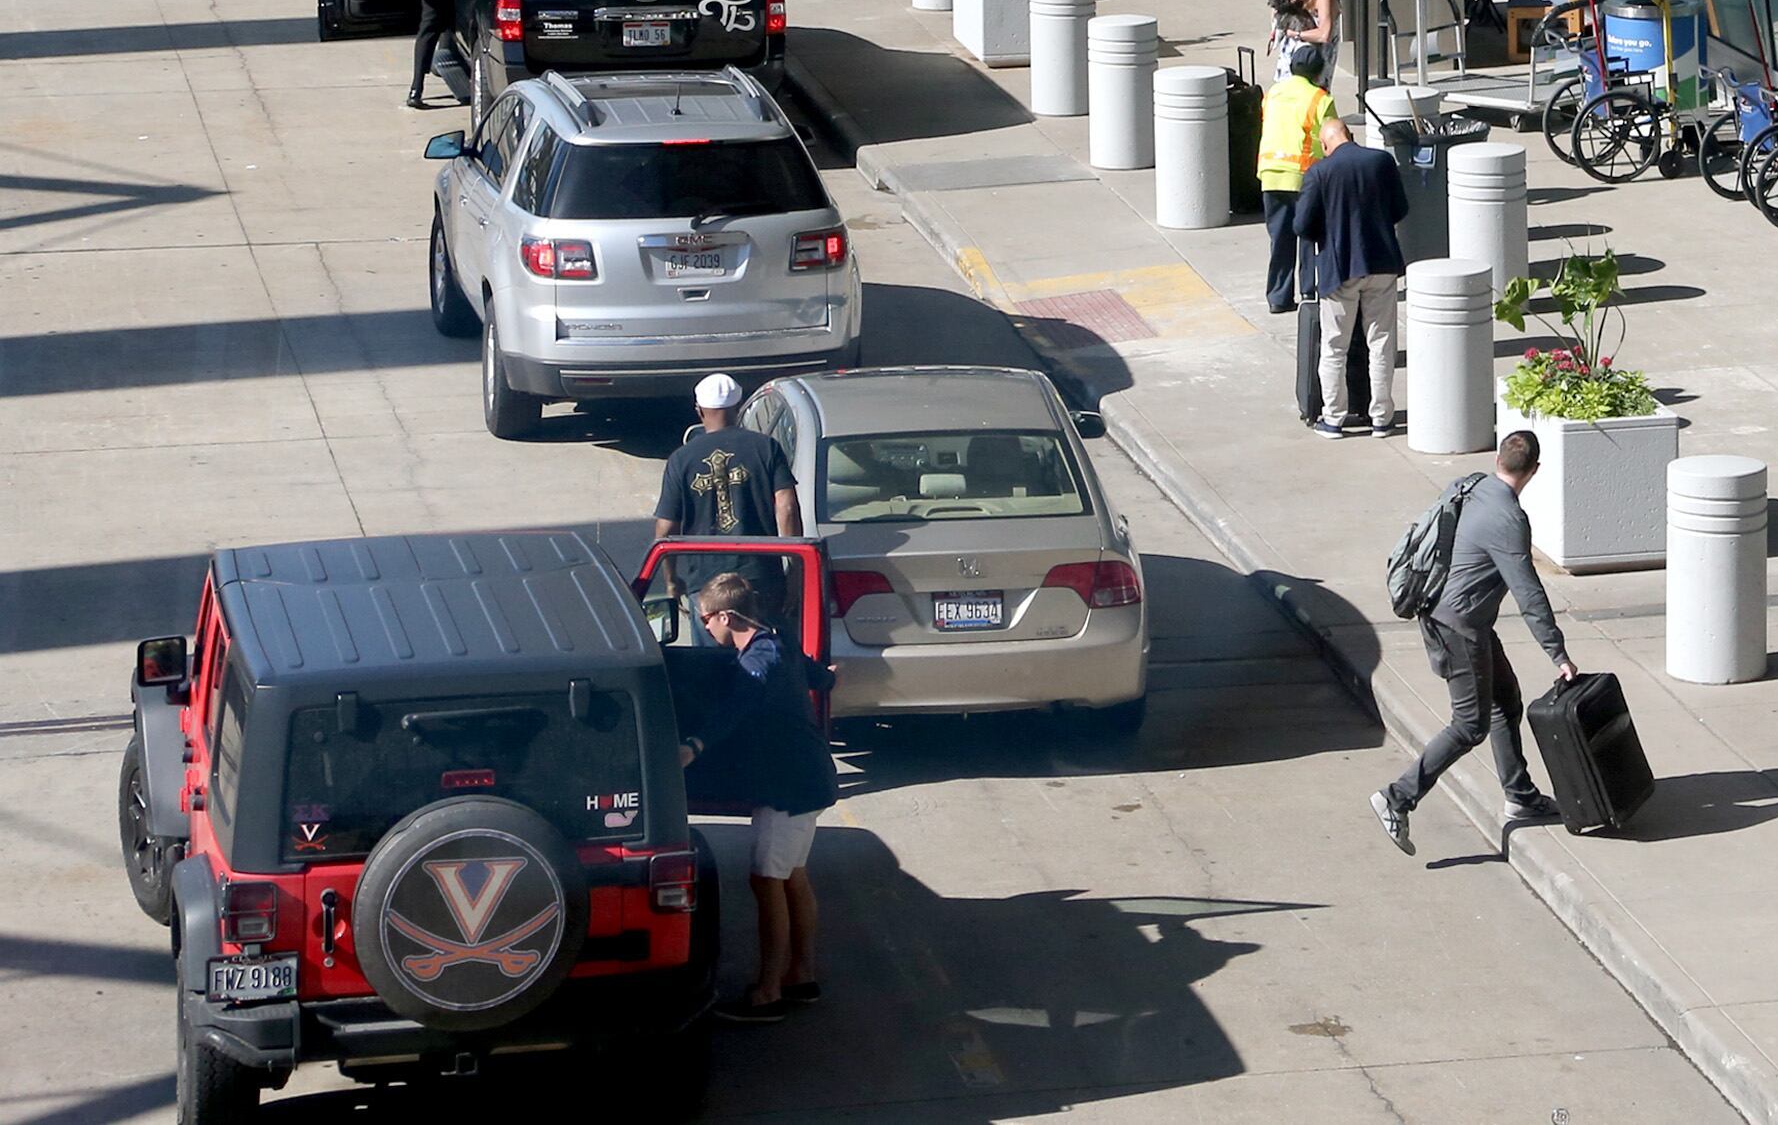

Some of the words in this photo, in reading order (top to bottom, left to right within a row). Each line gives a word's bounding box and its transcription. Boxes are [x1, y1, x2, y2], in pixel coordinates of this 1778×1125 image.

[655, 28, 665, 40] 56
[1623, 38, 1638, 47] you
[1638, 40, 1652, 48] go.
[675, 235, 713, 245] GMC
[694, 254, 720, 269] 2039
[300, 824, 320, 841] V
[422, 857, 528, 946] V
[214, 968, 245, 991] FWZ
[251, 966, 292, 990] 9188
